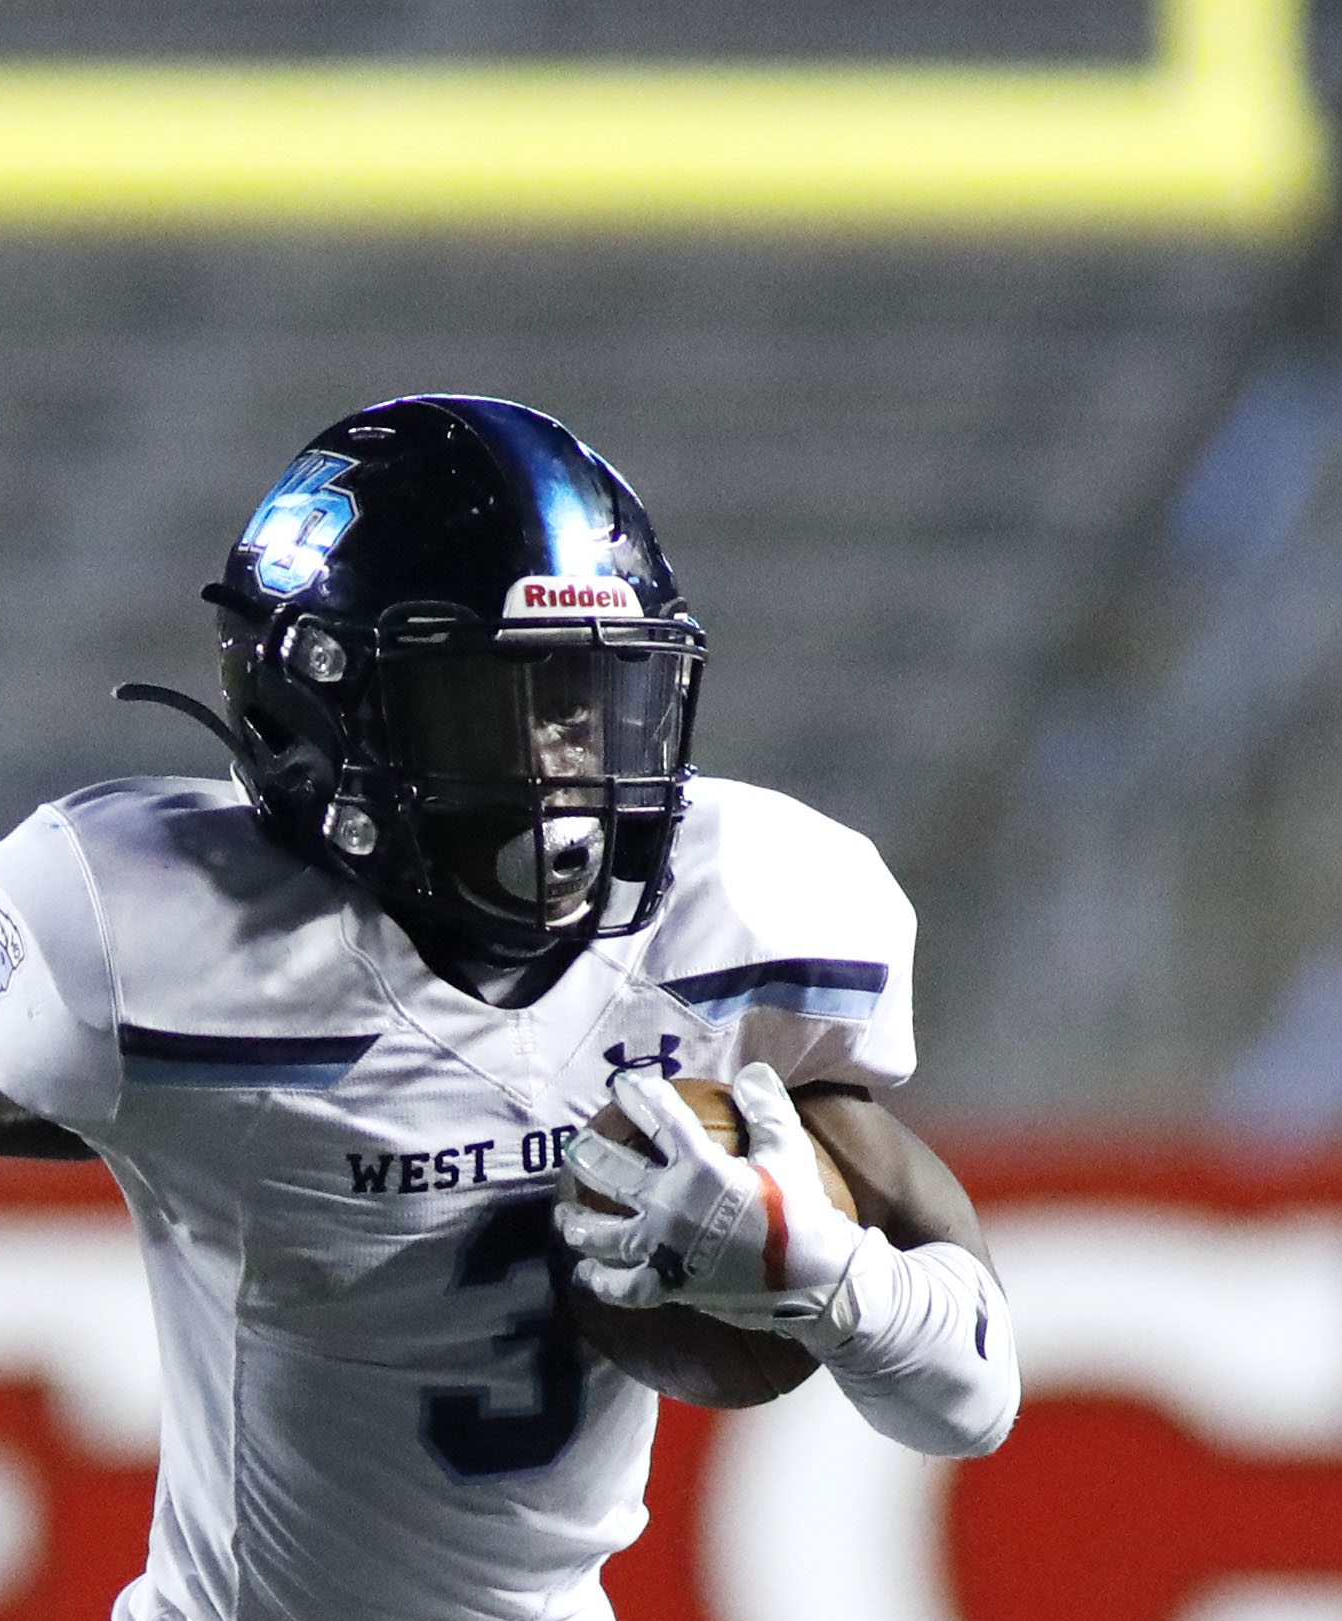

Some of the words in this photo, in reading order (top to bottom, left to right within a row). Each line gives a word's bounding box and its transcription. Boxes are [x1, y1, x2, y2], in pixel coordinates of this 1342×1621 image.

[524, 584, 627, 608] Riddell
[346, 1139, 495, 1194] WEST
[419, 1192, 588, 1486] 3
